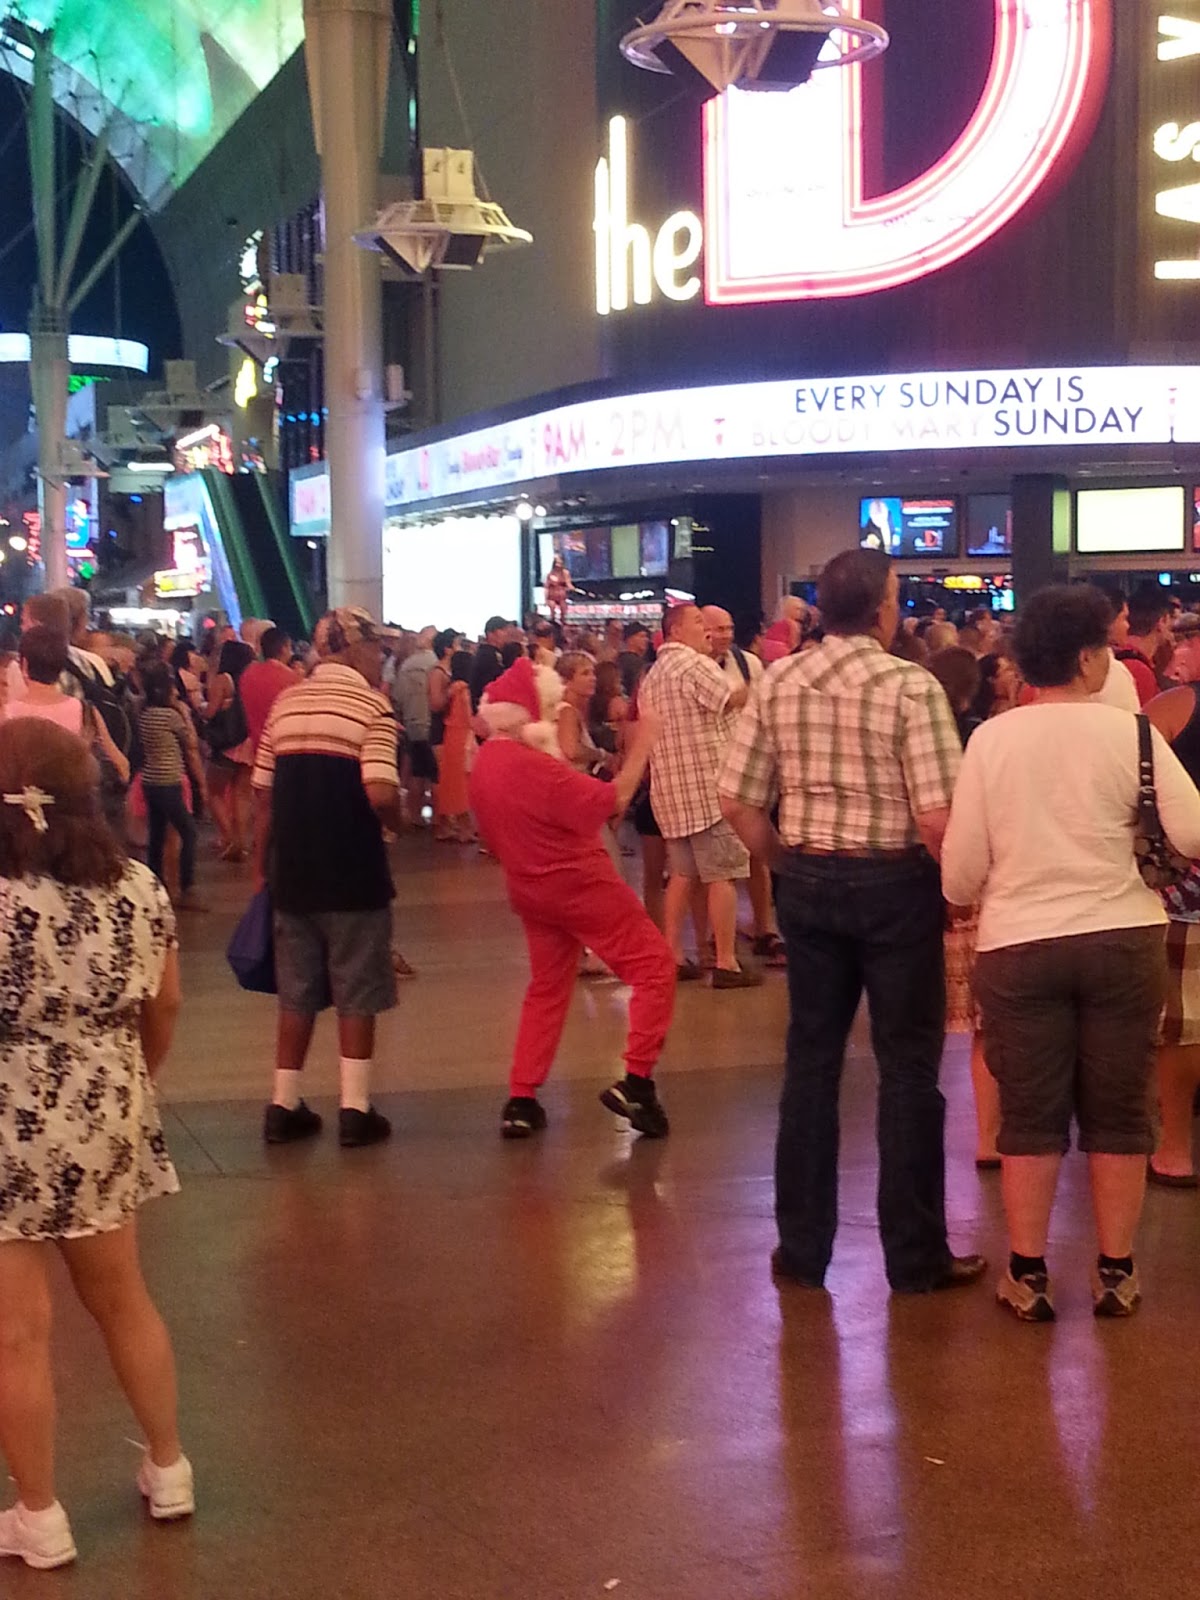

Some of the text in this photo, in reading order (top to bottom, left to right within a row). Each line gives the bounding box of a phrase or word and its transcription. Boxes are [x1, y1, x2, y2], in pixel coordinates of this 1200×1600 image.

[593, 115, 703, 315] the
[795, 374, 1085, 414] EVERY SUNDAY IS
[609, 408, 688, 458] 2PM
[993, 406, 1144, 437] SUNDAY
